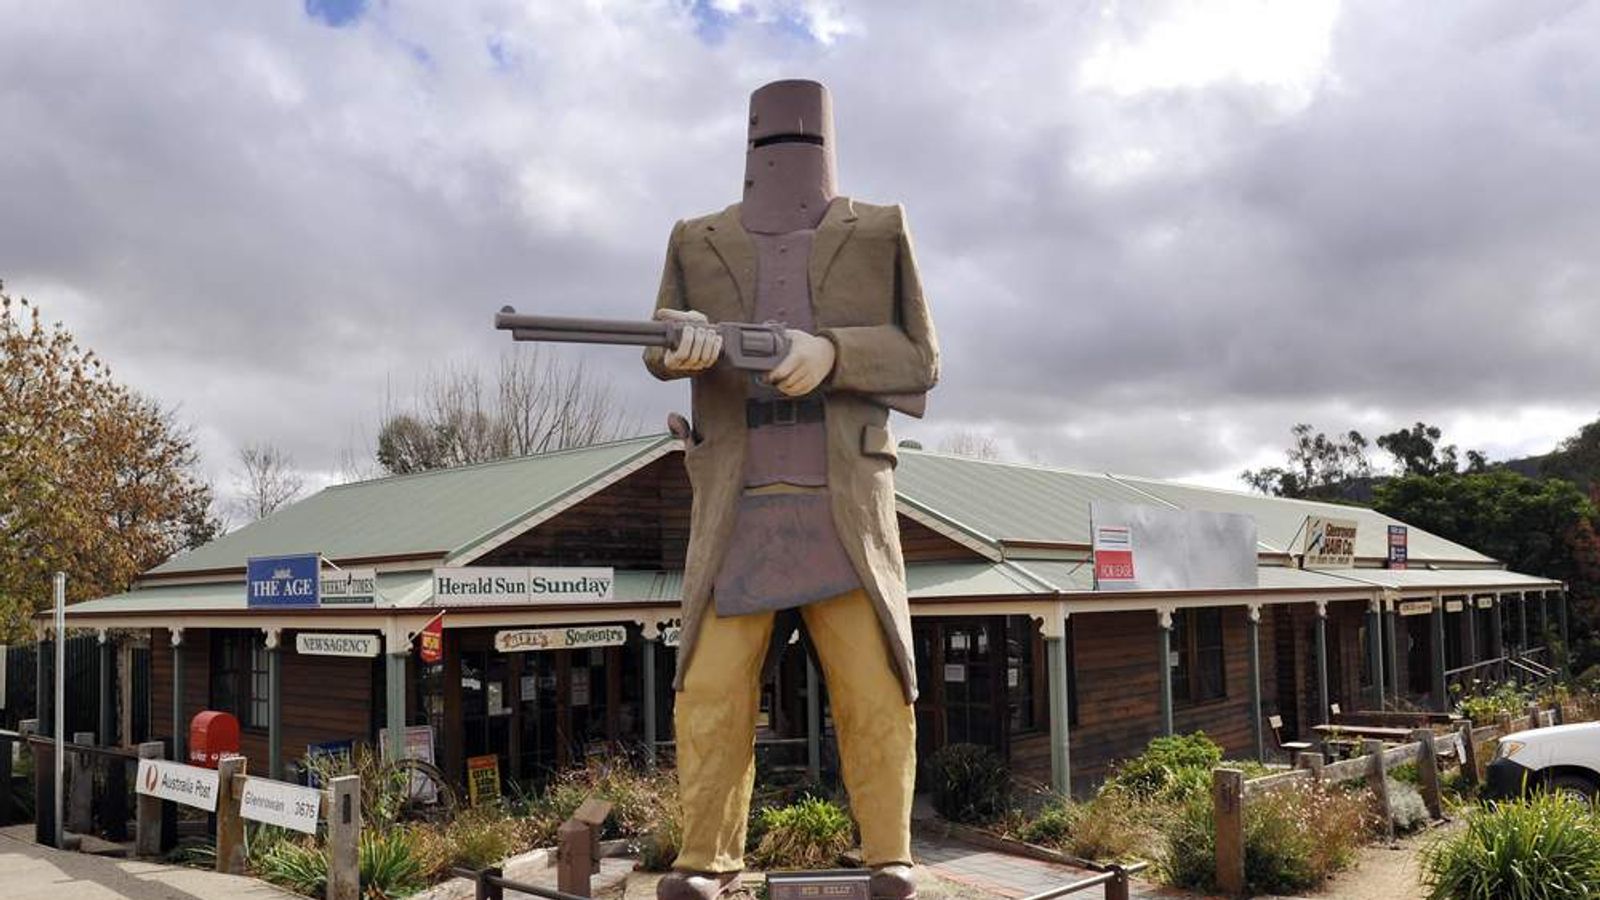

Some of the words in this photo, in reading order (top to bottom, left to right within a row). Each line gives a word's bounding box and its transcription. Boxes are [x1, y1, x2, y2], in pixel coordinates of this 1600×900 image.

[252, 580, 280, 597] THE
[283, 578, 313, 596] AGE
[438, 577, 492, 594] Herald
[494, 577, 526, 594] Sun
[532, 576, 611, 597] Sunday
[303, 638, 370, 653] NEWSAGENCY
[161, 773, 194, 793] Australia
[195, 780, 211, 798] Post
[244, 791, 285, 811] Glenrowan
[294, 800, 315, 819] 3675
[801, 886, 819, 896] NED
[822, 886, 852, 895] KELLY
